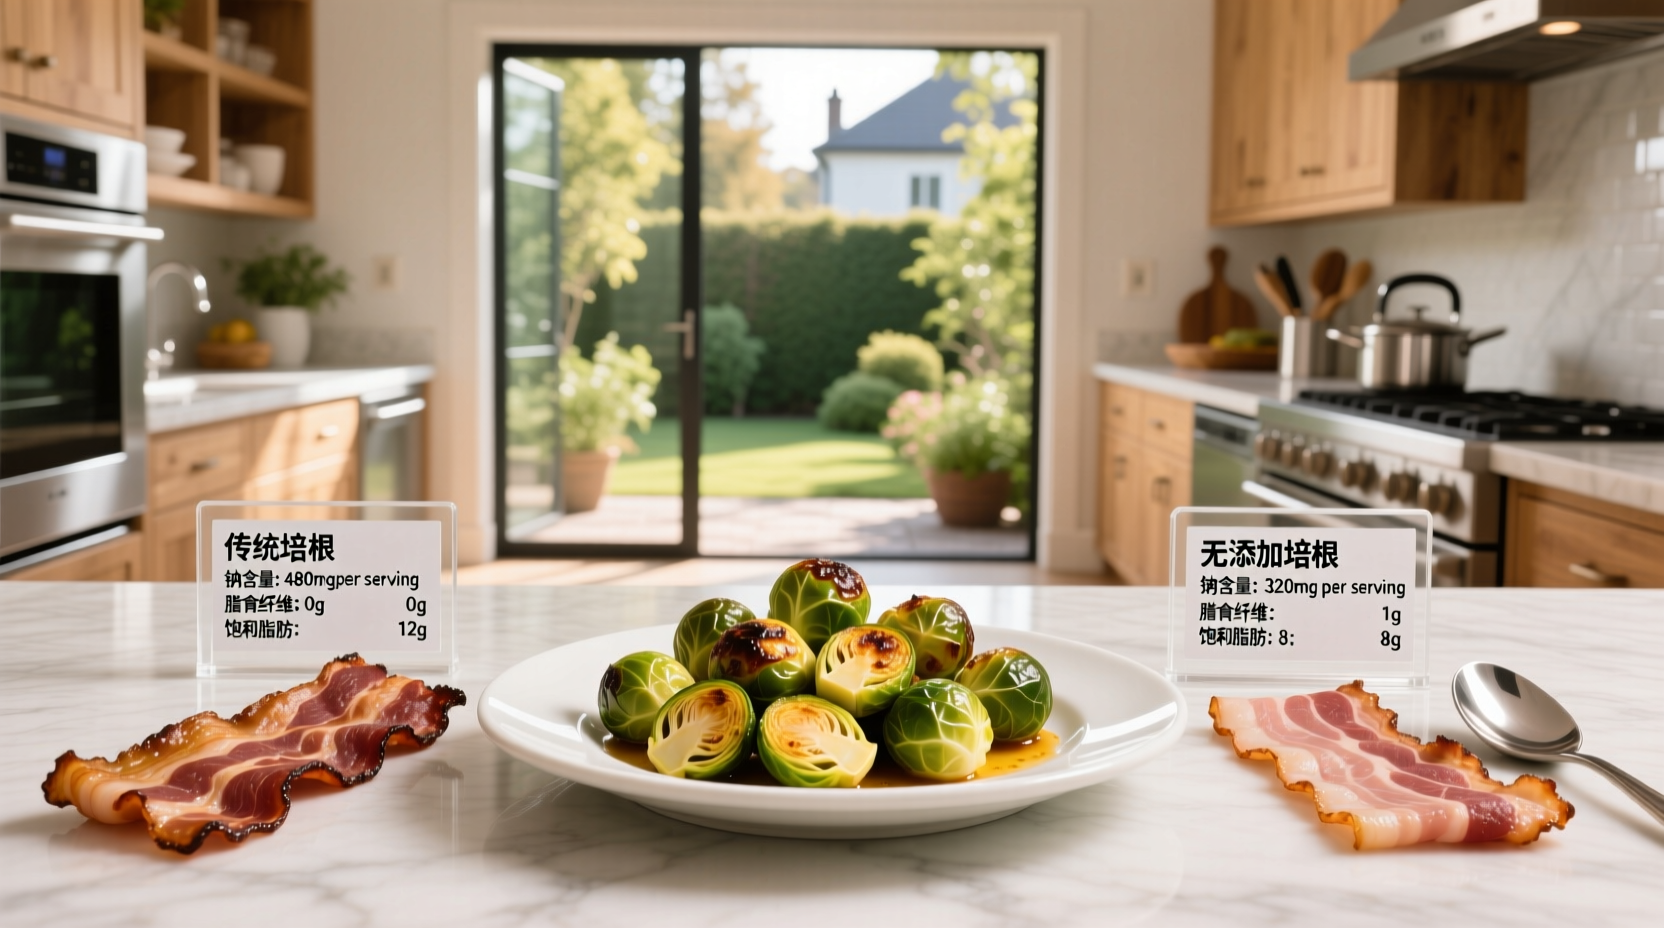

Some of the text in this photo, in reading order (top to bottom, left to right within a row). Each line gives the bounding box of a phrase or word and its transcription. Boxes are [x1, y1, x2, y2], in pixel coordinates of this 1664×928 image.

[224, 532, 335, 562] 传统培根
[1200, 538, 1339, 568] 无添加培根
[364, 570, 419, 591] serving
[1264, 578, 1318, 598] 320mg
[1321, 583, 1347, 599] per
[1351, 579, 1406, 598] serving
[304, 596, 325, 616] 0g
[405, 596, 427, 617] 0g
[1382, 606, 1401, 626] 1g
[398, 620, 427, 641] 12g
[1380, 630, 1401, 651] 8g
